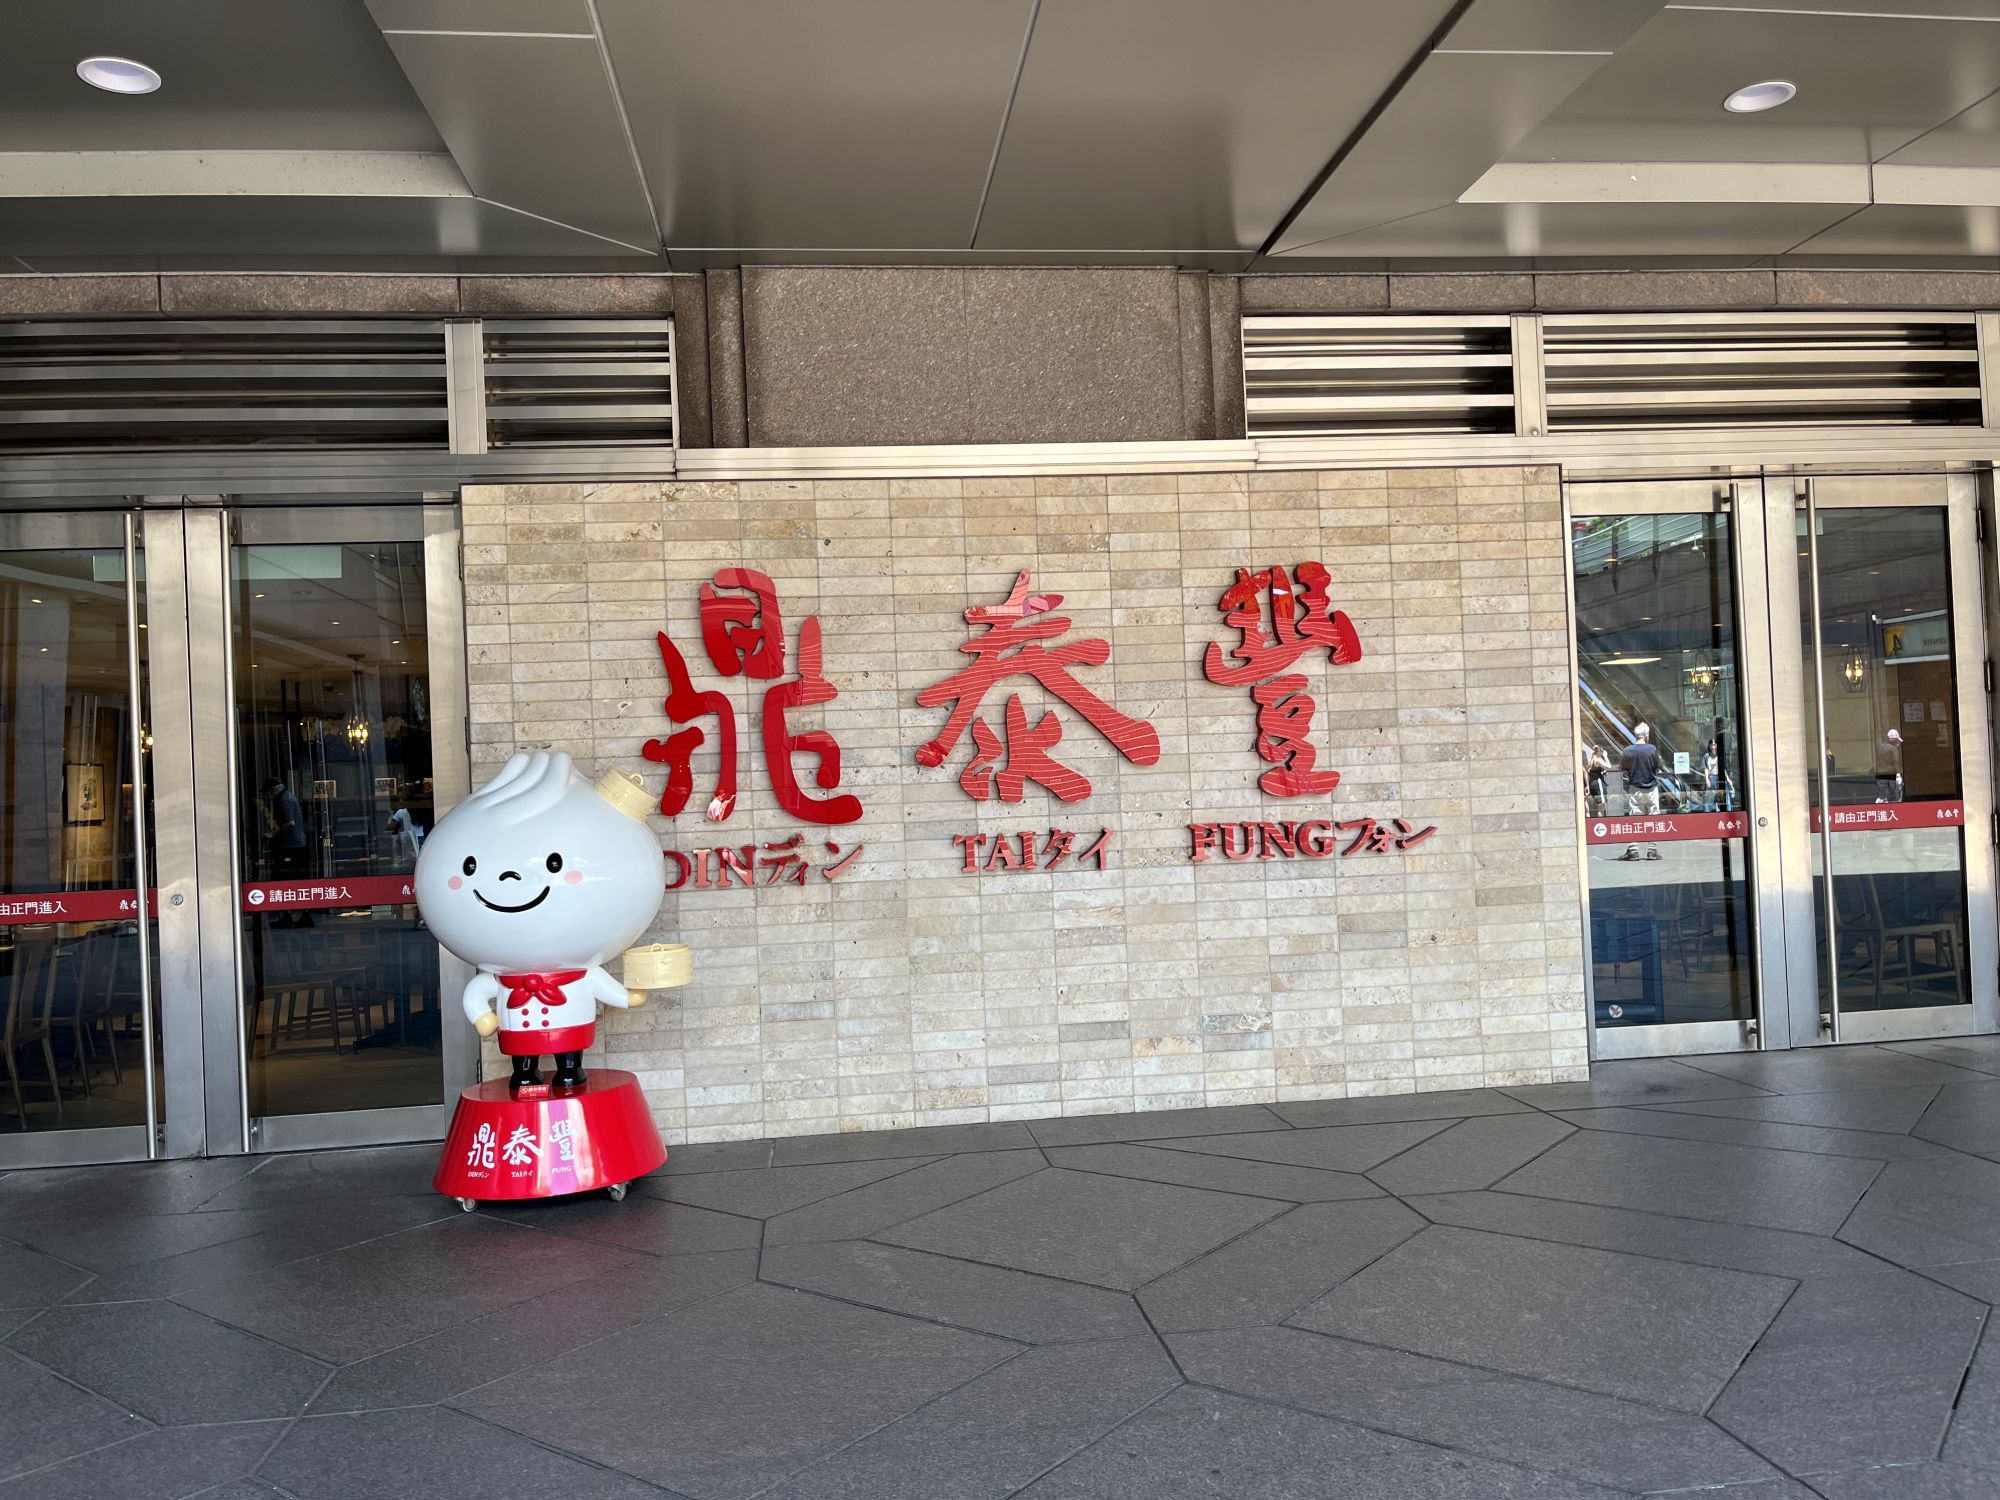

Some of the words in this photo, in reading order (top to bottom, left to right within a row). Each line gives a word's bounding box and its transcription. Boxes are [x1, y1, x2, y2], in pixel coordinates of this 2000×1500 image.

[1834, 809, 1898, 824] 請由正門進入
[1610, 821, 1677, 835] 請由正門進入
[953, 827, 1115, 873] TAIタイ
[1187, 817, 1438, 861] FUNGフォン
[269, 886, 352, 903] 請由正門進入
[467, 1119, 577, 1169] 鼎泰豐
